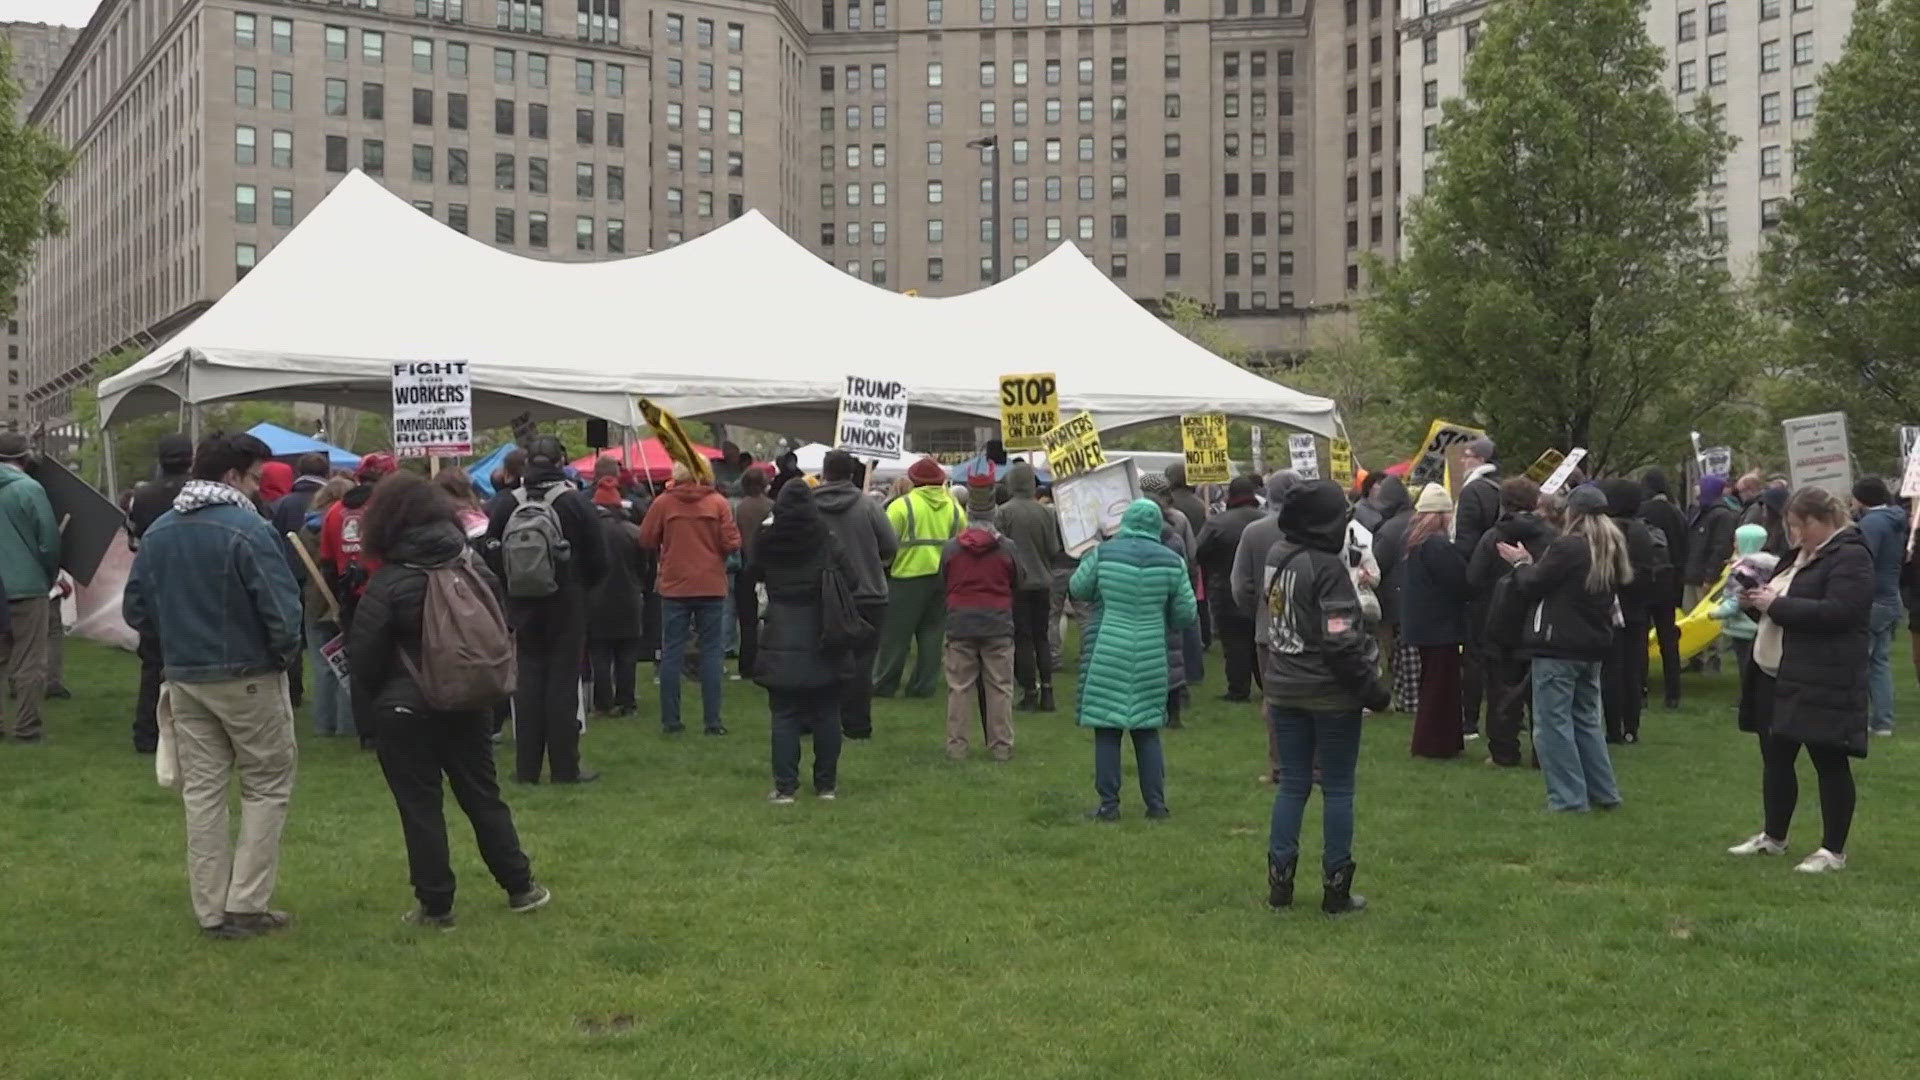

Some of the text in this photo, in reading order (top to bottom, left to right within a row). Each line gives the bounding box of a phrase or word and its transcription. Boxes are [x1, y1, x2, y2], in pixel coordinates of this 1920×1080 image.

[394, 362, 467, 376] FIGHT
[395, 385, 468, 405] WORKERS'
[847, 376, 906, 400] TRUMP:
[1002, 377, 1055, 407] STOP
[843, 400, 904, 418] HANDS OFF
[1007, 410, 1055, 426] THE WAR
[396, 431, 469, 442] RIGHTS
[840, 425, 900, 450] UNIONS!
[1008, 426, 1022, 438] ON
[1053, 441, 1105, 479] POWER
[1187, 449, 1226, 465] NOT THE
